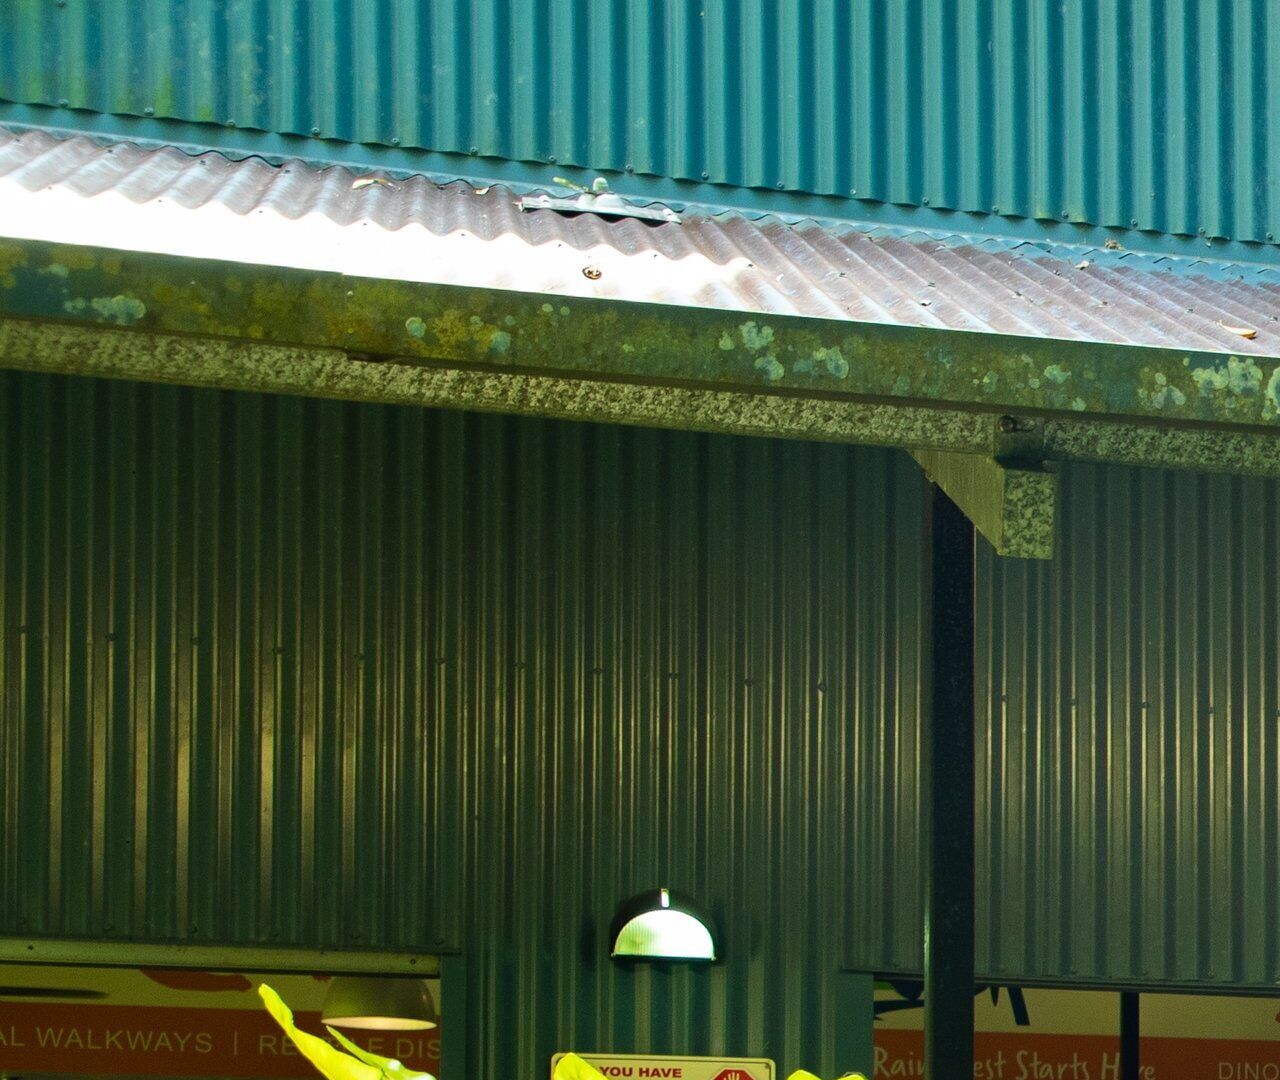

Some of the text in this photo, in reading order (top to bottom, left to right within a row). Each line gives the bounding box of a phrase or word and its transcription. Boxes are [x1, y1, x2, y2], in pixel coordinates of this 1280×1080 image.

[36, 1027, 213, 1054] WALKWAYS
[599, 1066, 683, 1079] YOU HAVE
[873, 1046, 1007, 1080] Rainest
